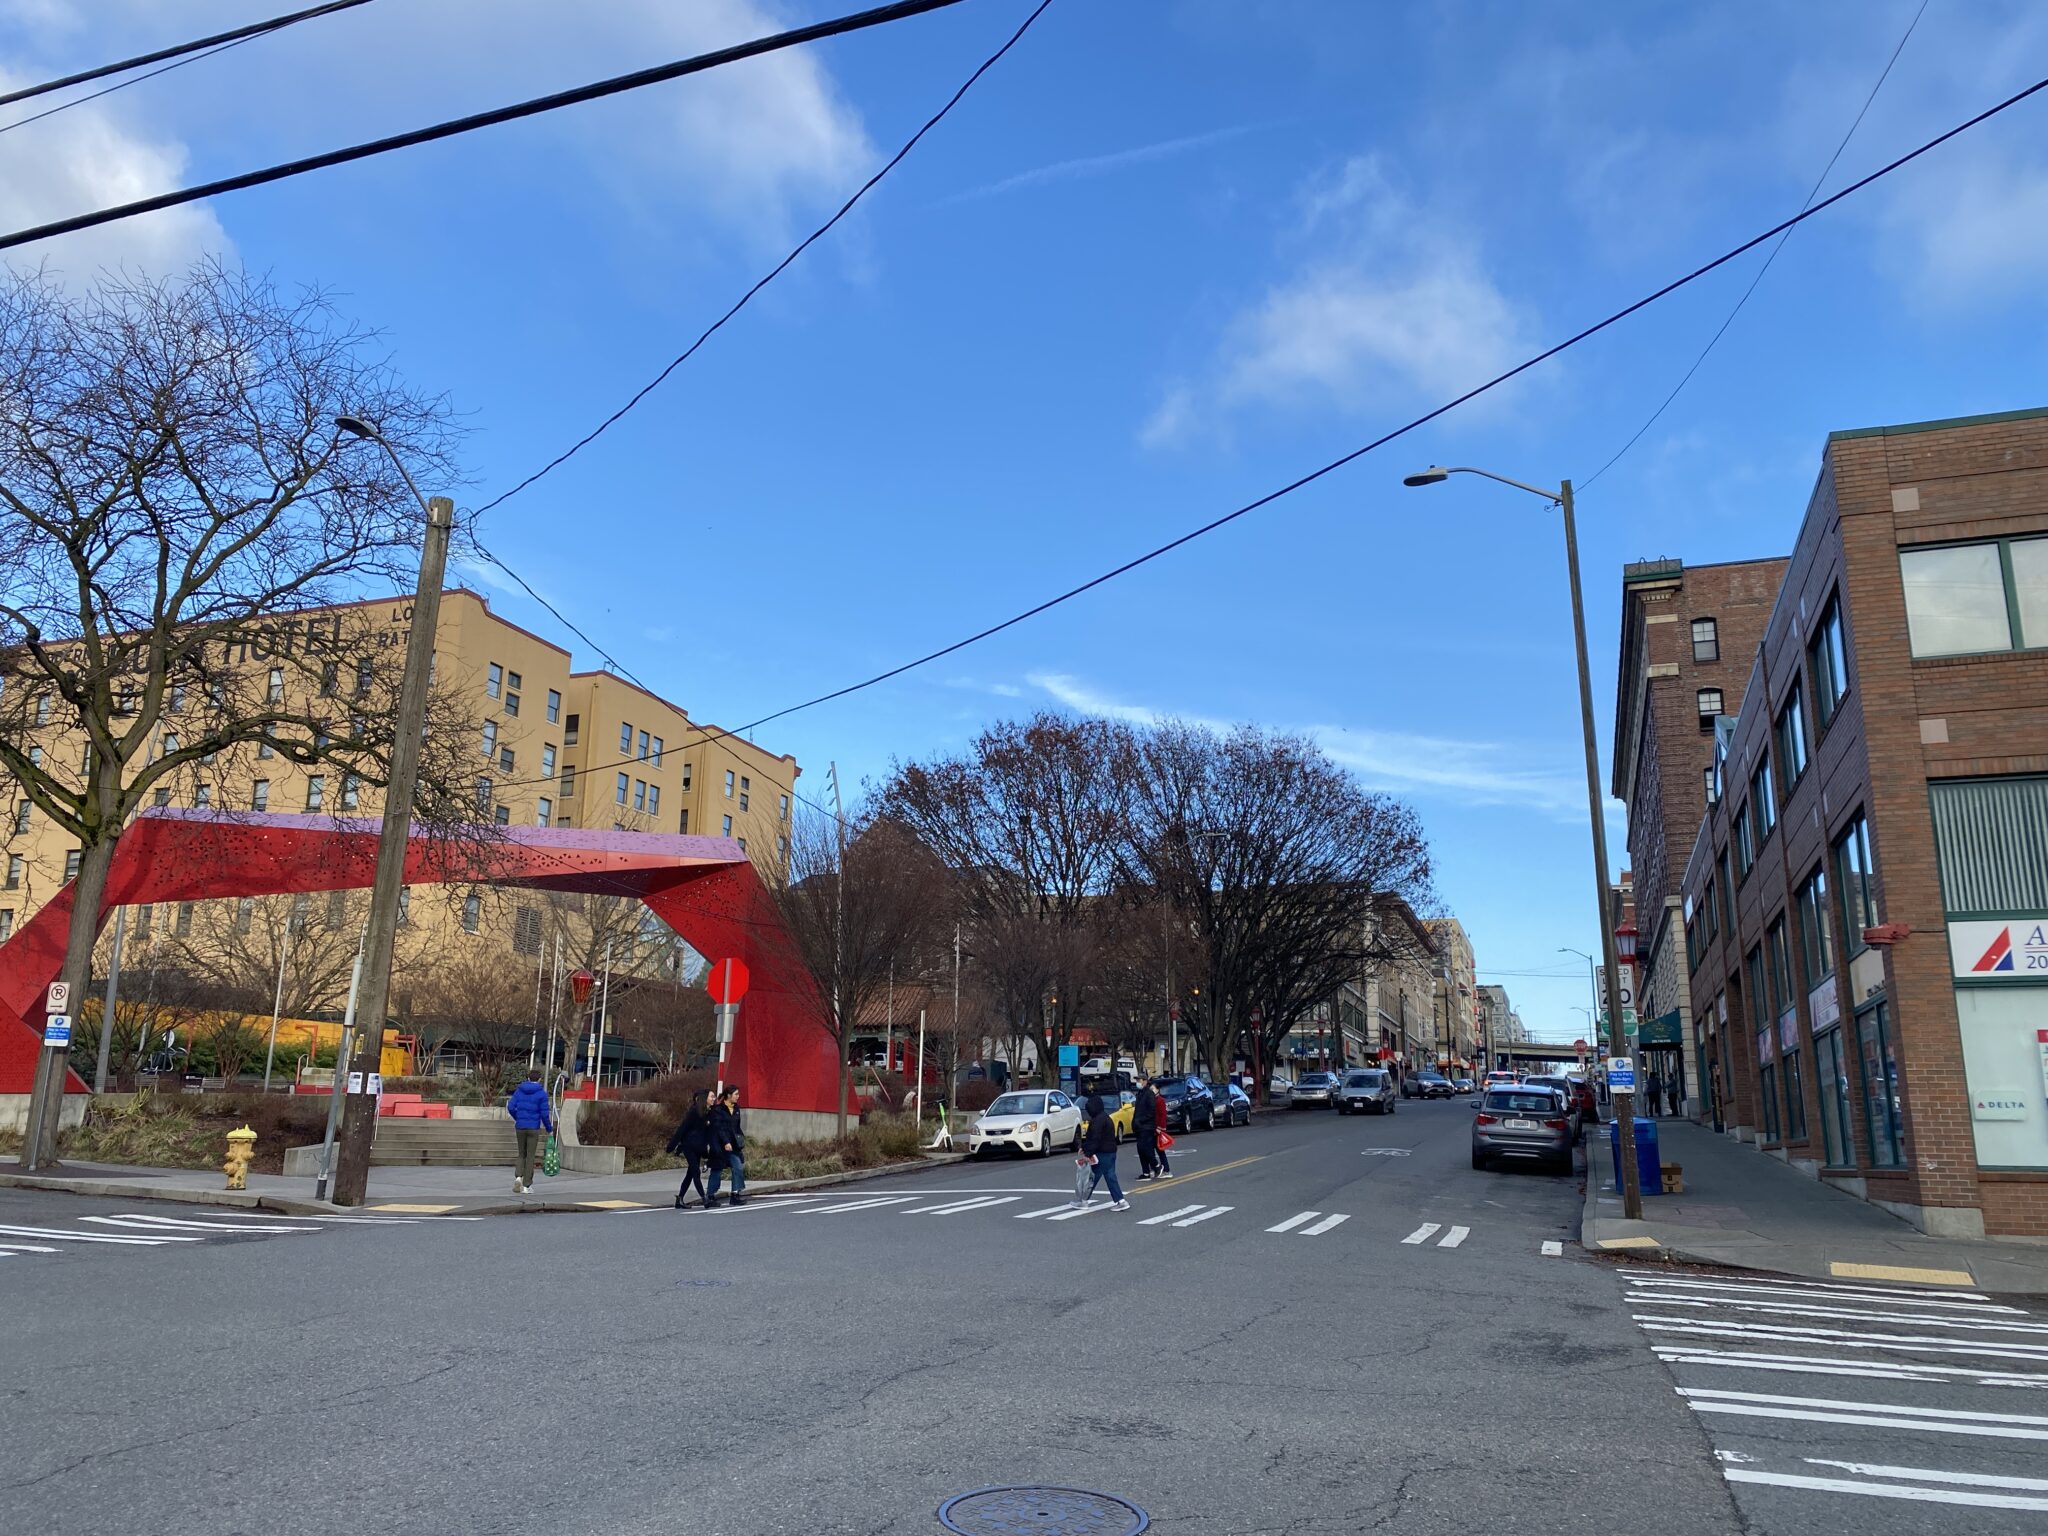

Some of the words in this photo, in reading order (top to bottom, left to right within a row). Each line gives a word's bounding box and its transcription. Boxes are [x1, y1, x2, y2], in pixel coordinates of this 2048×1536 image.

[392, 606, 414, 623] LO
[222, 614, 350, 665] HOTEL
[377, 629, 412, 648] RAT
